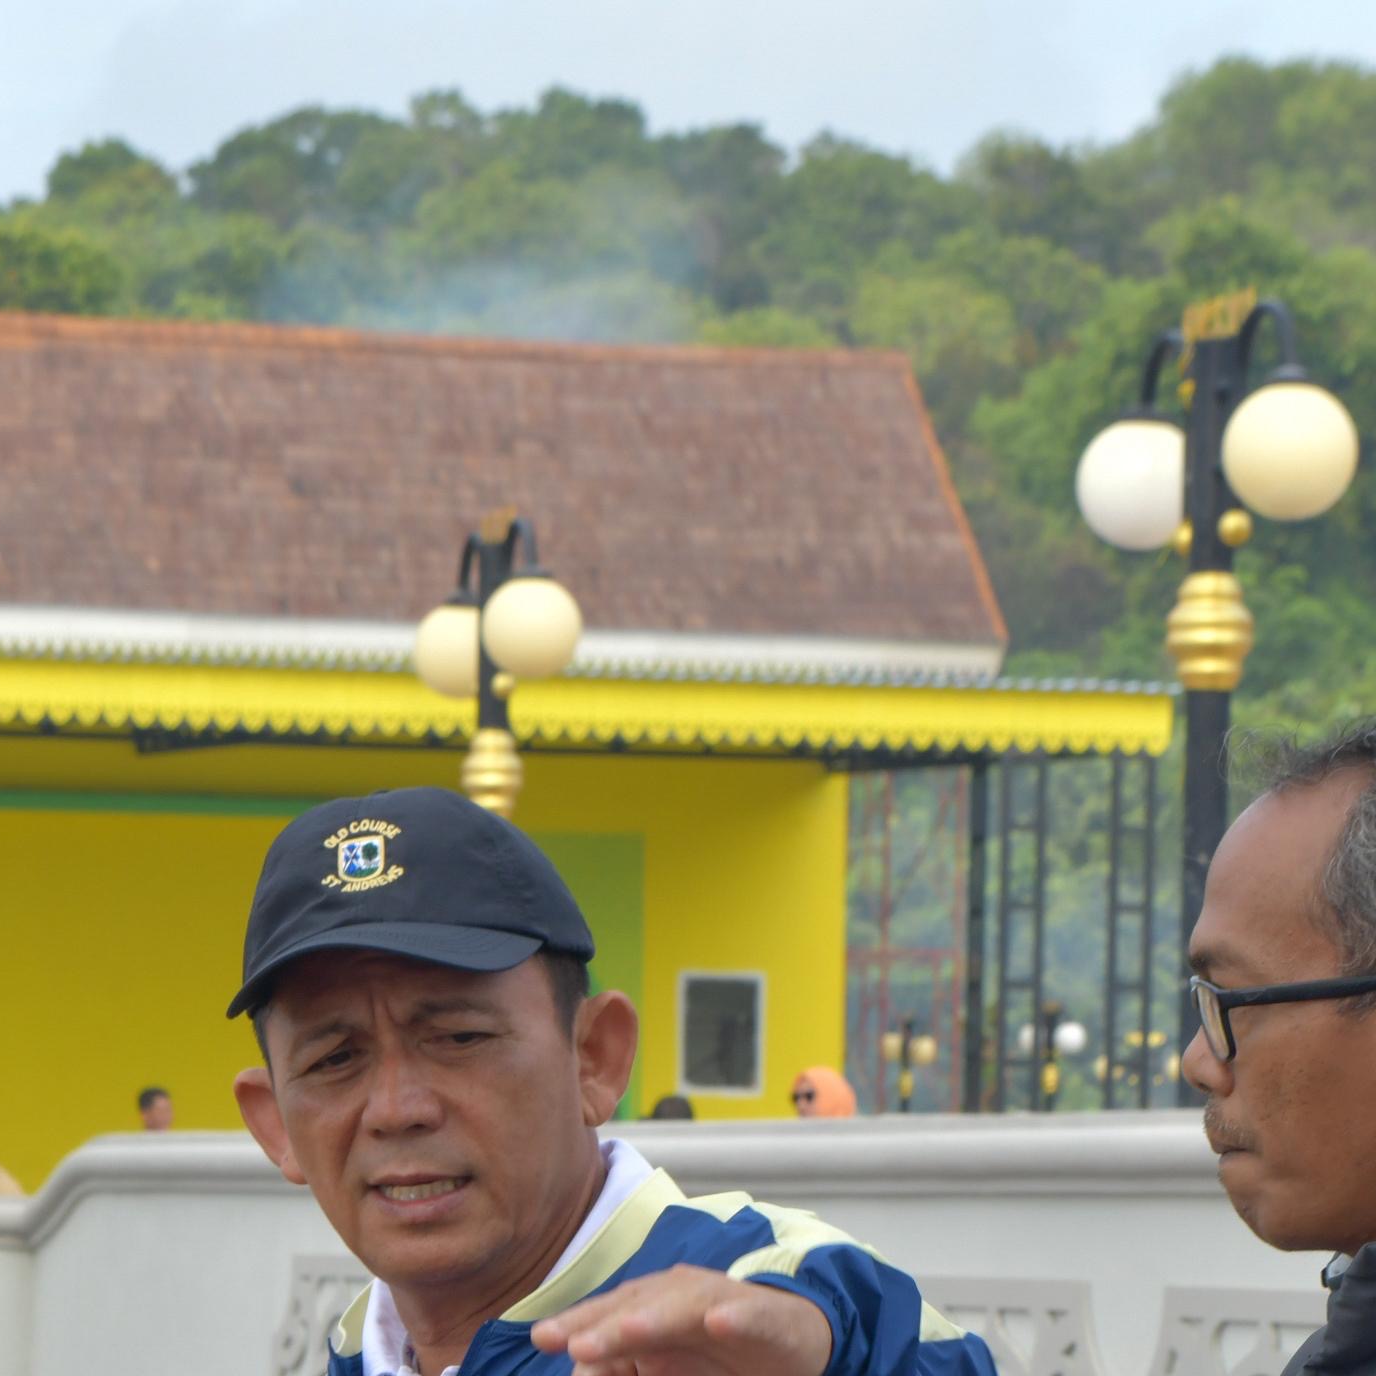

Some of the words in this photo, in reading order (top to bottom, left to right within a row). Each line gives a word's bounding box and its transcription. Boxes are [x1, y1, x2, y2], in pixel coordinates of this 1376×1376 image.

[324, 827, 349, 848] OLD
[349, 818, 401, 839] COURSE
[321, 874, 342, 888] ST
[340, 864, 404, 892] ANDREWS
